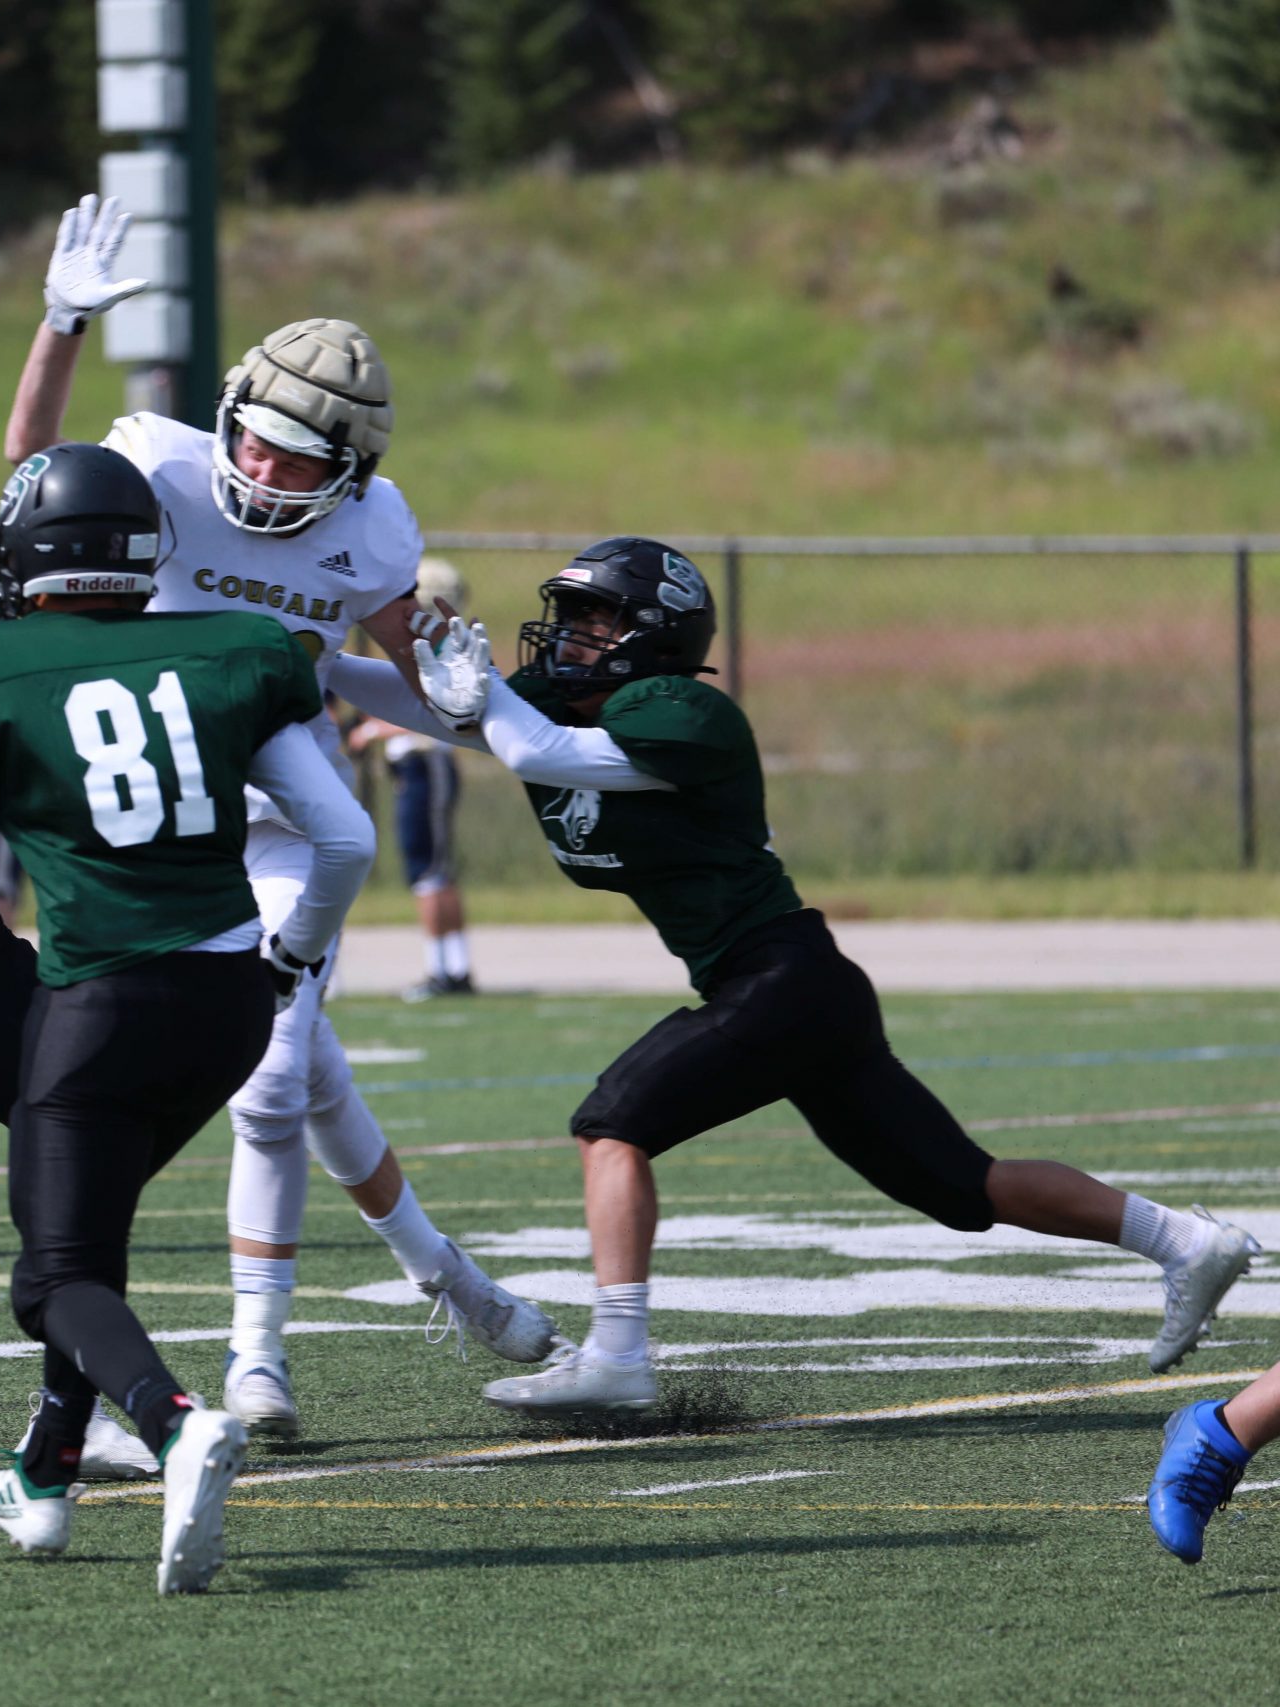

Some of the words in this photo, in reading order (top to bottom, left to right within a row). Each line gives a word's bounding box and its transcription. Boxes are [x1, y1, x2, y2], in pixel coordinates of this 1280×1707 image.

[65, 576, 137, 592] Riddell
[194, 568, 345, 622] COUGARS
[63, 670, 217, 848] 81
